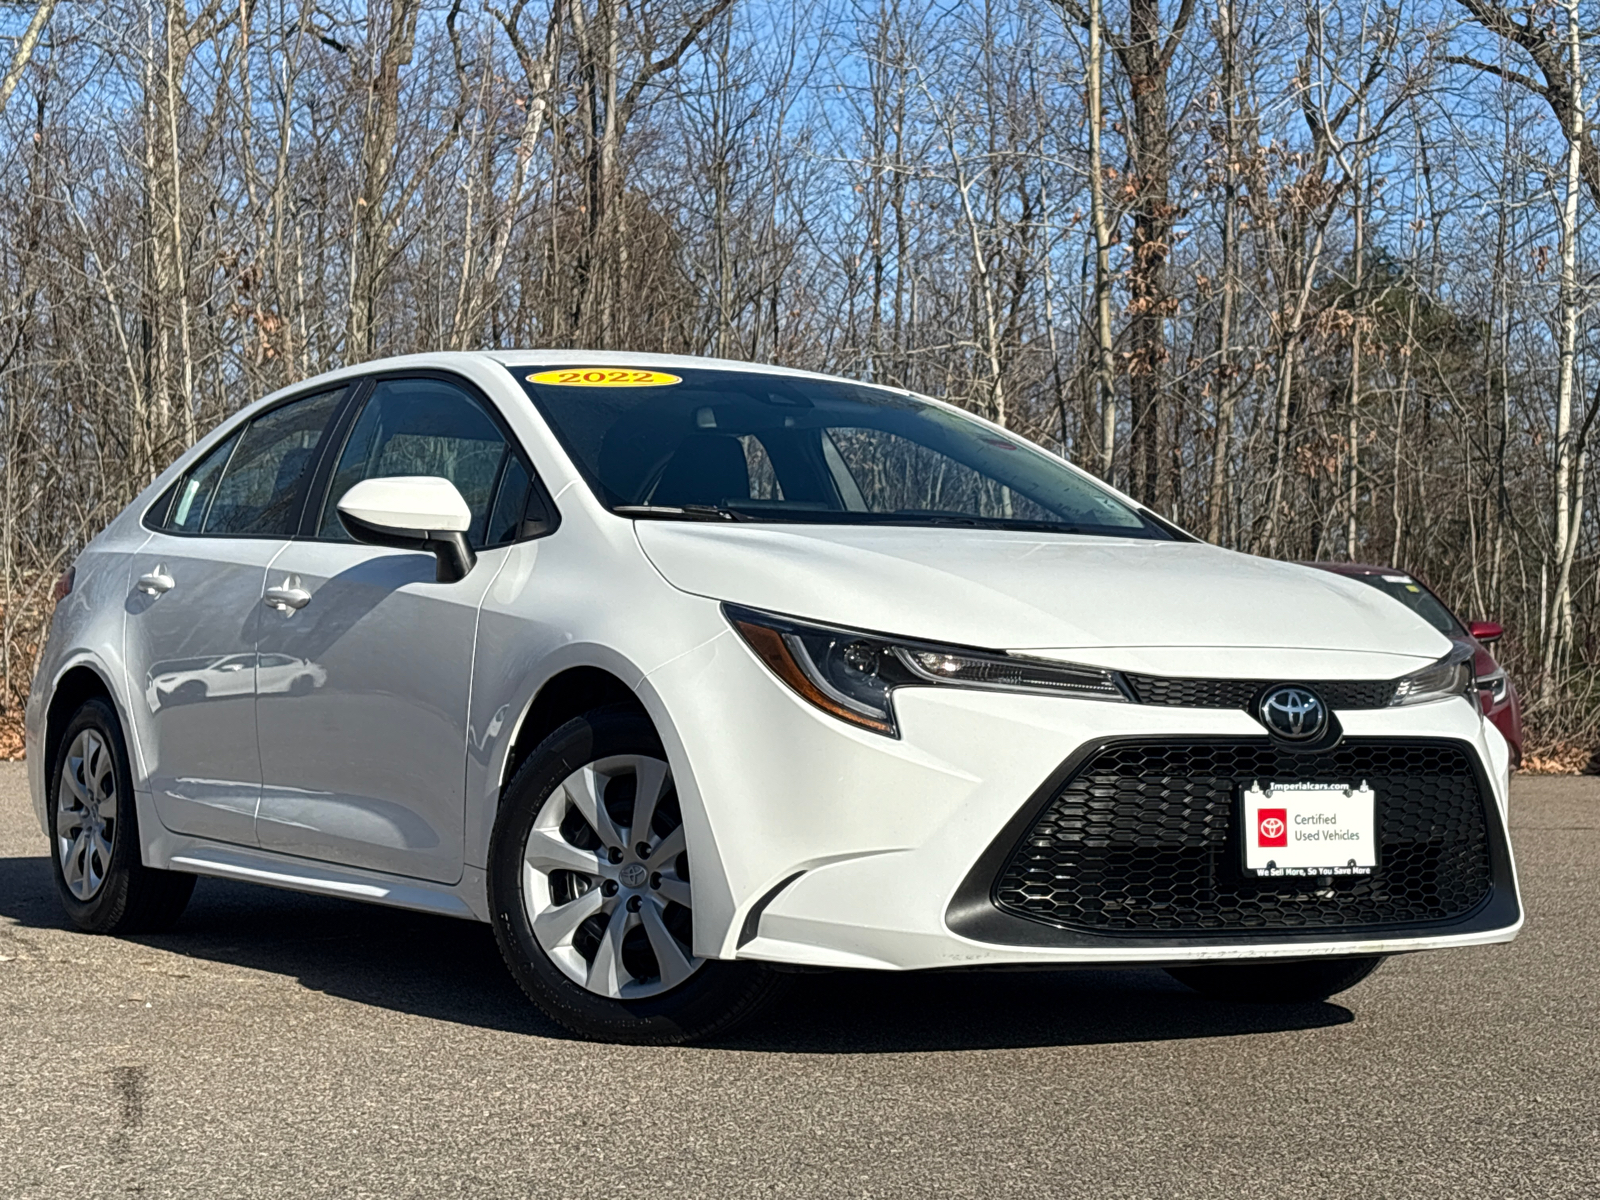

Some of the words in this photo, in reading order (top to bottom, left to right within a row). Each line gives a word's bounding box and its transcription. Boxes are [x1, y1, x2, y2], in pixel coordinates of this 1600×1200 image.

[559, 372, 654, 383] 2022
[1270, 782, 1349, 792] Imperialcars.com
[1294, 814, 1336, 824] Certified
[1295, 830, 1320, 841] Used
[1322, 830, 1360, 840] Vehicles
